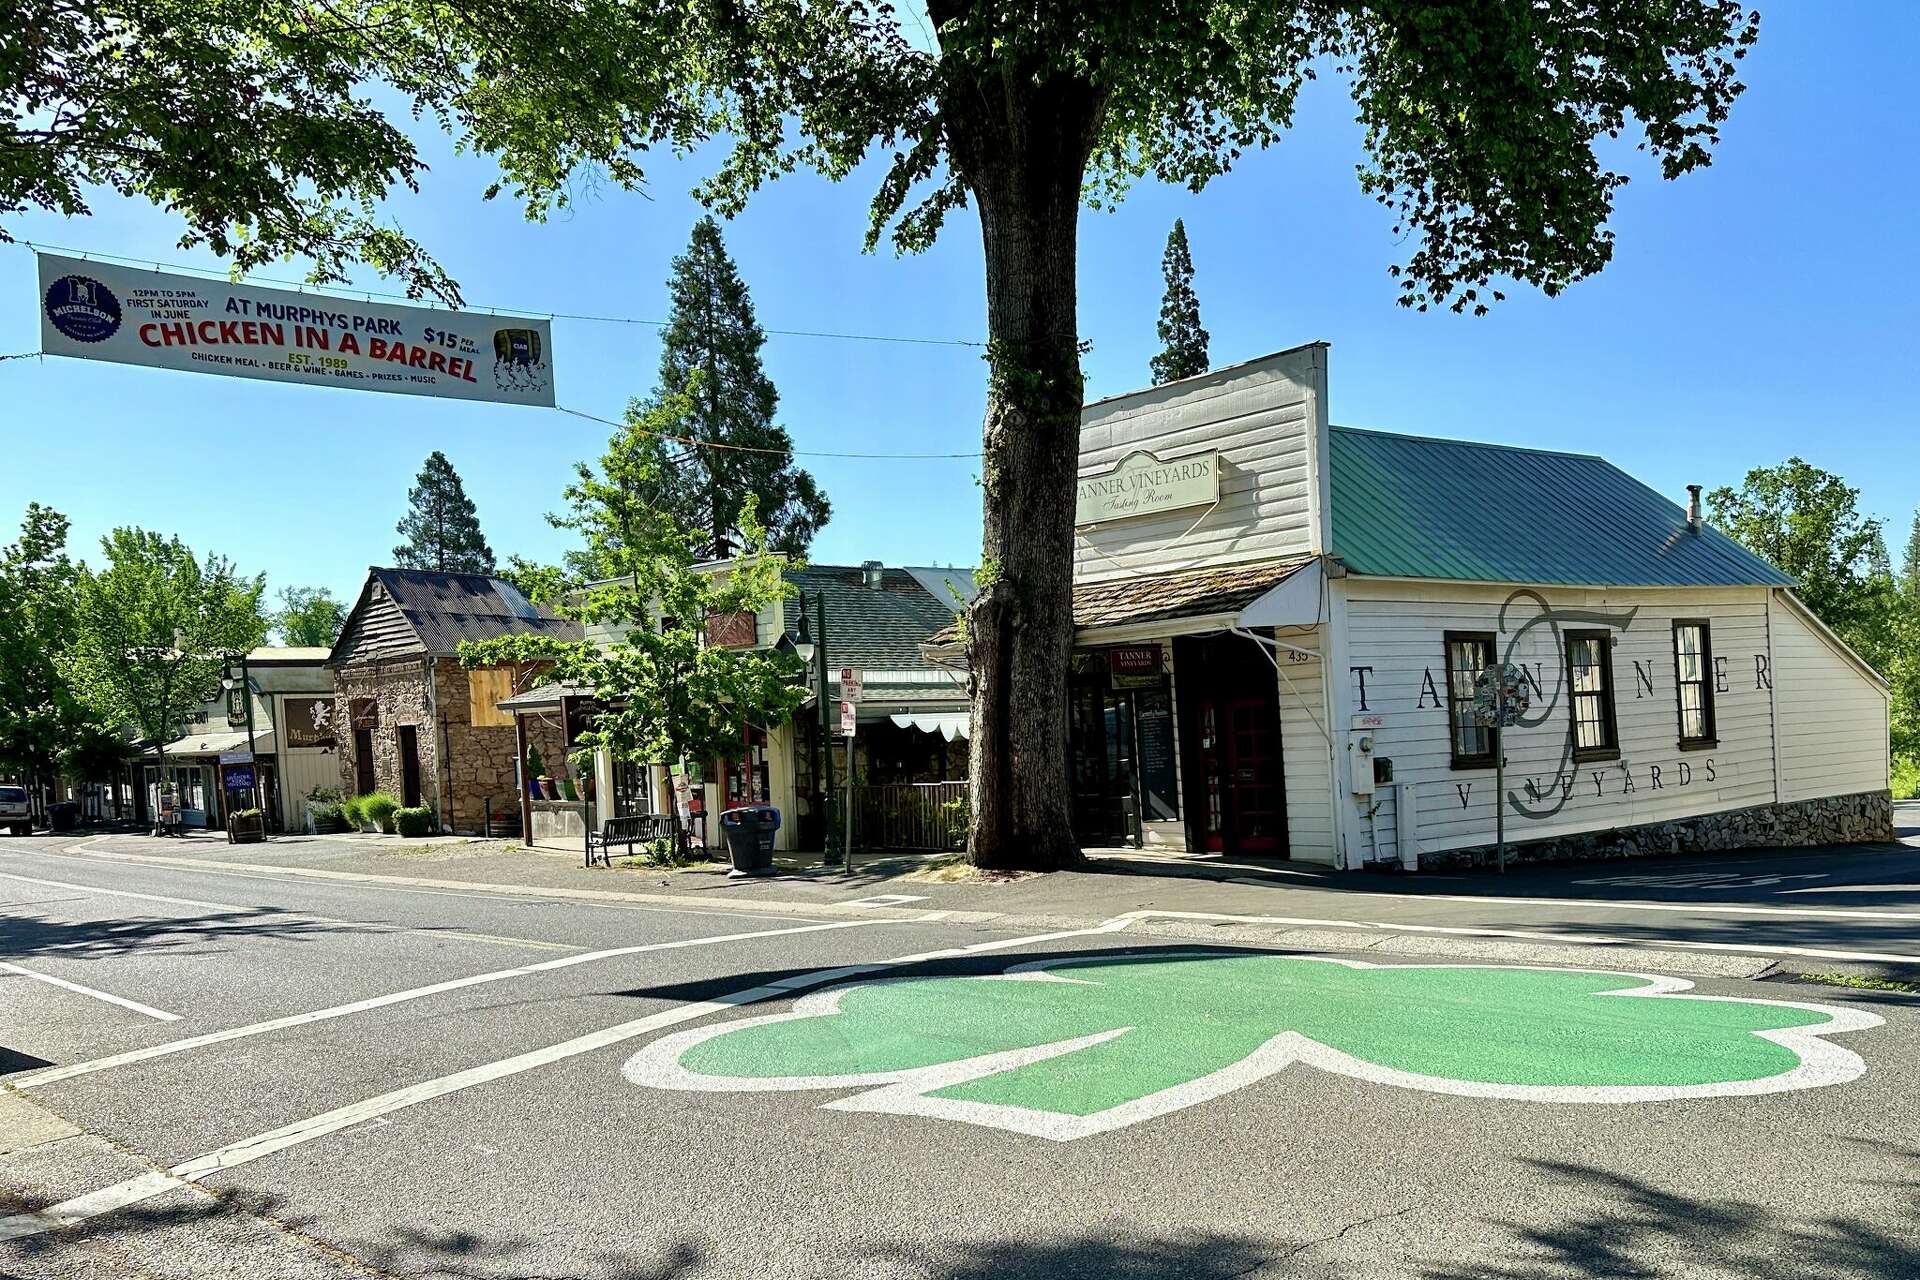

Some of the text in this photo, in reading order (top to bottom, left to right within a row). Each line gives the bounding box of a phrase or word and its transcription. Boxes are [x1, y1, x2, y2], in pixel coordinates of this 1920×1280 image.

[53, 304, 116, 323] MICHELSON
[127, 299, 209, 308] FIRST SATURDAY
[151, 310, 190, 319] IN JUNE
[225, 297, 403, 335] AT MURPHYS PARK
[424, 326, 457, 349] $15
[461, 338, 474, 347] PER
[139, 321, 478, 383] CHICKEN IN A BARREL
[460, 346, 480, 354] MEAL
[191, 352, 436, 384] CHICKEN MEAL BEER & WINE GAMES PRIZES MUSIC
[288, 353, 348, 369] EST. 1989
[1079, 461, 1209, 500] ANNER VINEYARDS
[1104, 489, 1173, 512] Tasting Room
[1120, 651, 1151, 660] TANNER
[1289, 650, 1308, 662] 435
[1350, 654, 1773, 712] TANNER
[1456, 759, 1717, 811] VNEYARDS
